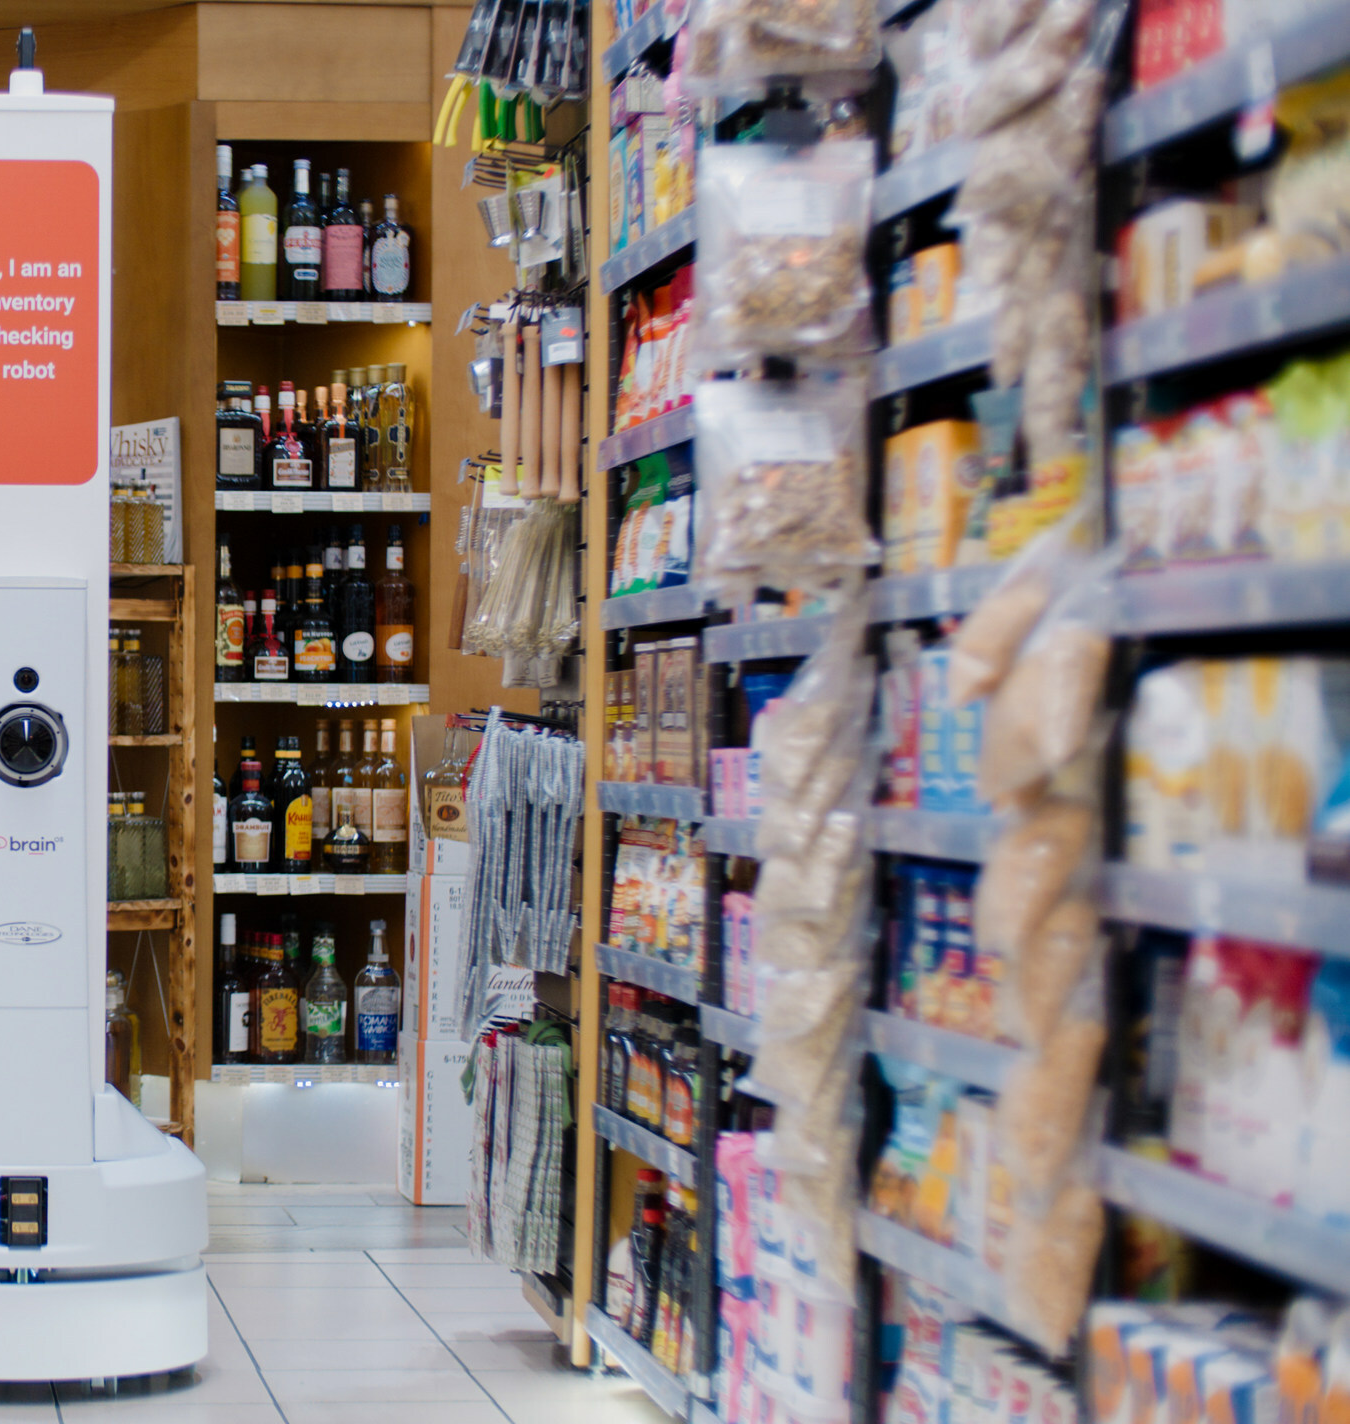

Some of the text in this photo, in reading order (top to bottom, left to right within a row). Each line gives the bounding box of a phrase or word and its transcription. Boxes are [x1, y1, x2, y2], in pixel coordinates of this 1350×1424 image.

[9, 258, 15, 277] I
[21, 262, 52, 278] am
[57, 262, 82, 278] an
[2, 359, 56, 379] robot
[10, 836, 56, 851] brain
